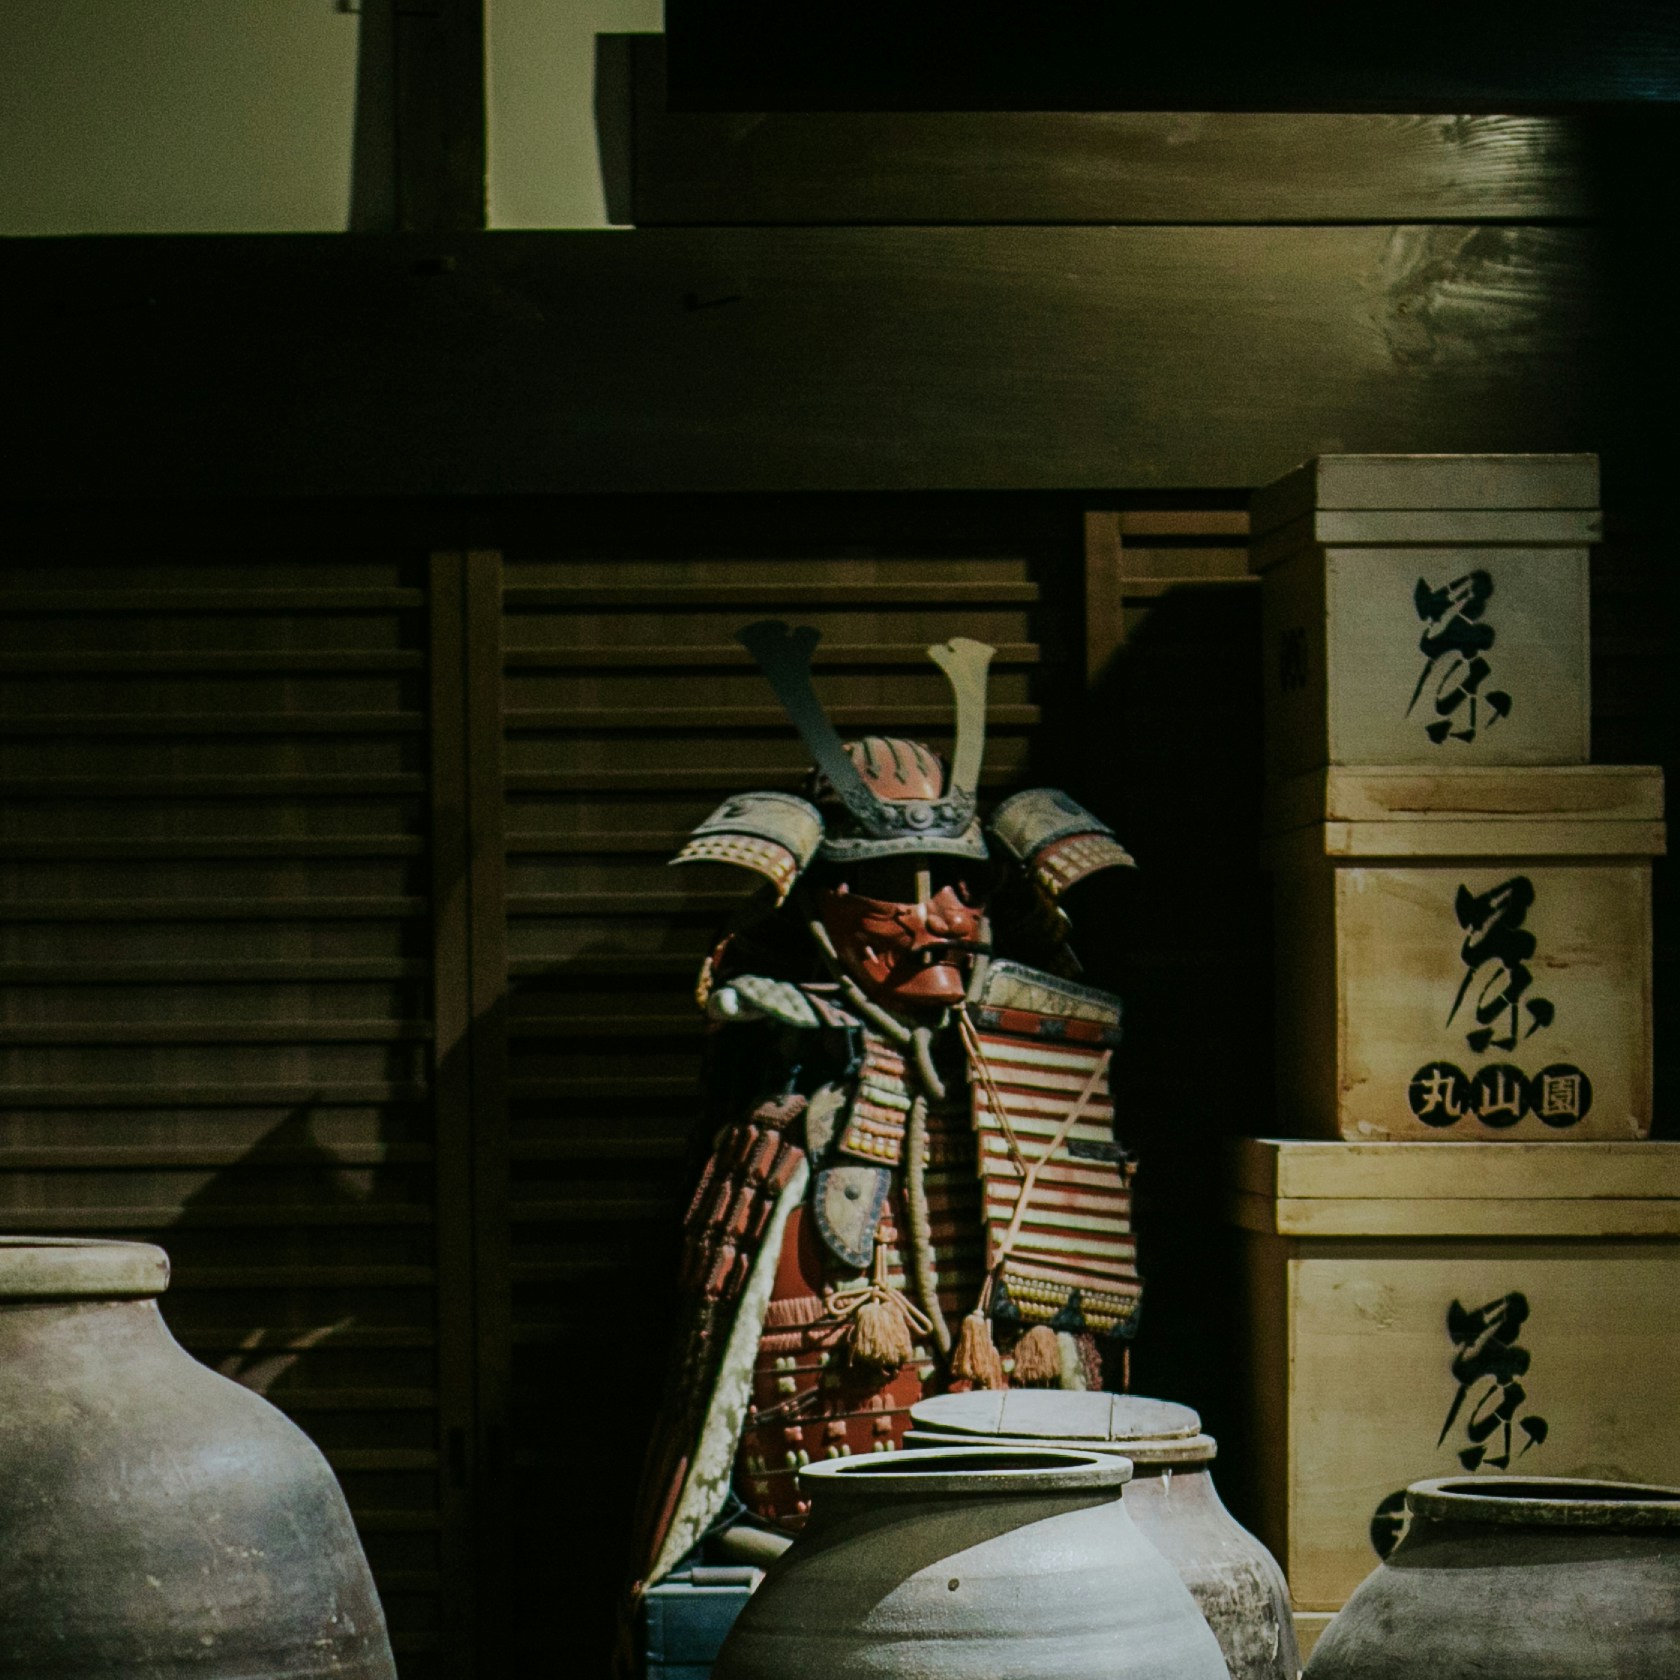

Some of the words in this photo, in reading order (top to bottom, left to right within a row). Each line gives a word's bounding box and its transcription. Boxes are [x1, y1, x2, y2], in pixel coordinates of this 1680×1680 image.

[1407, 568, 1513, 745] 茶
[1446, 874, 1555, 1054] 茶
[1416, 1066, 1584, 1121] 丸山園
[1438, 1291, 1549, 1472] 茶
